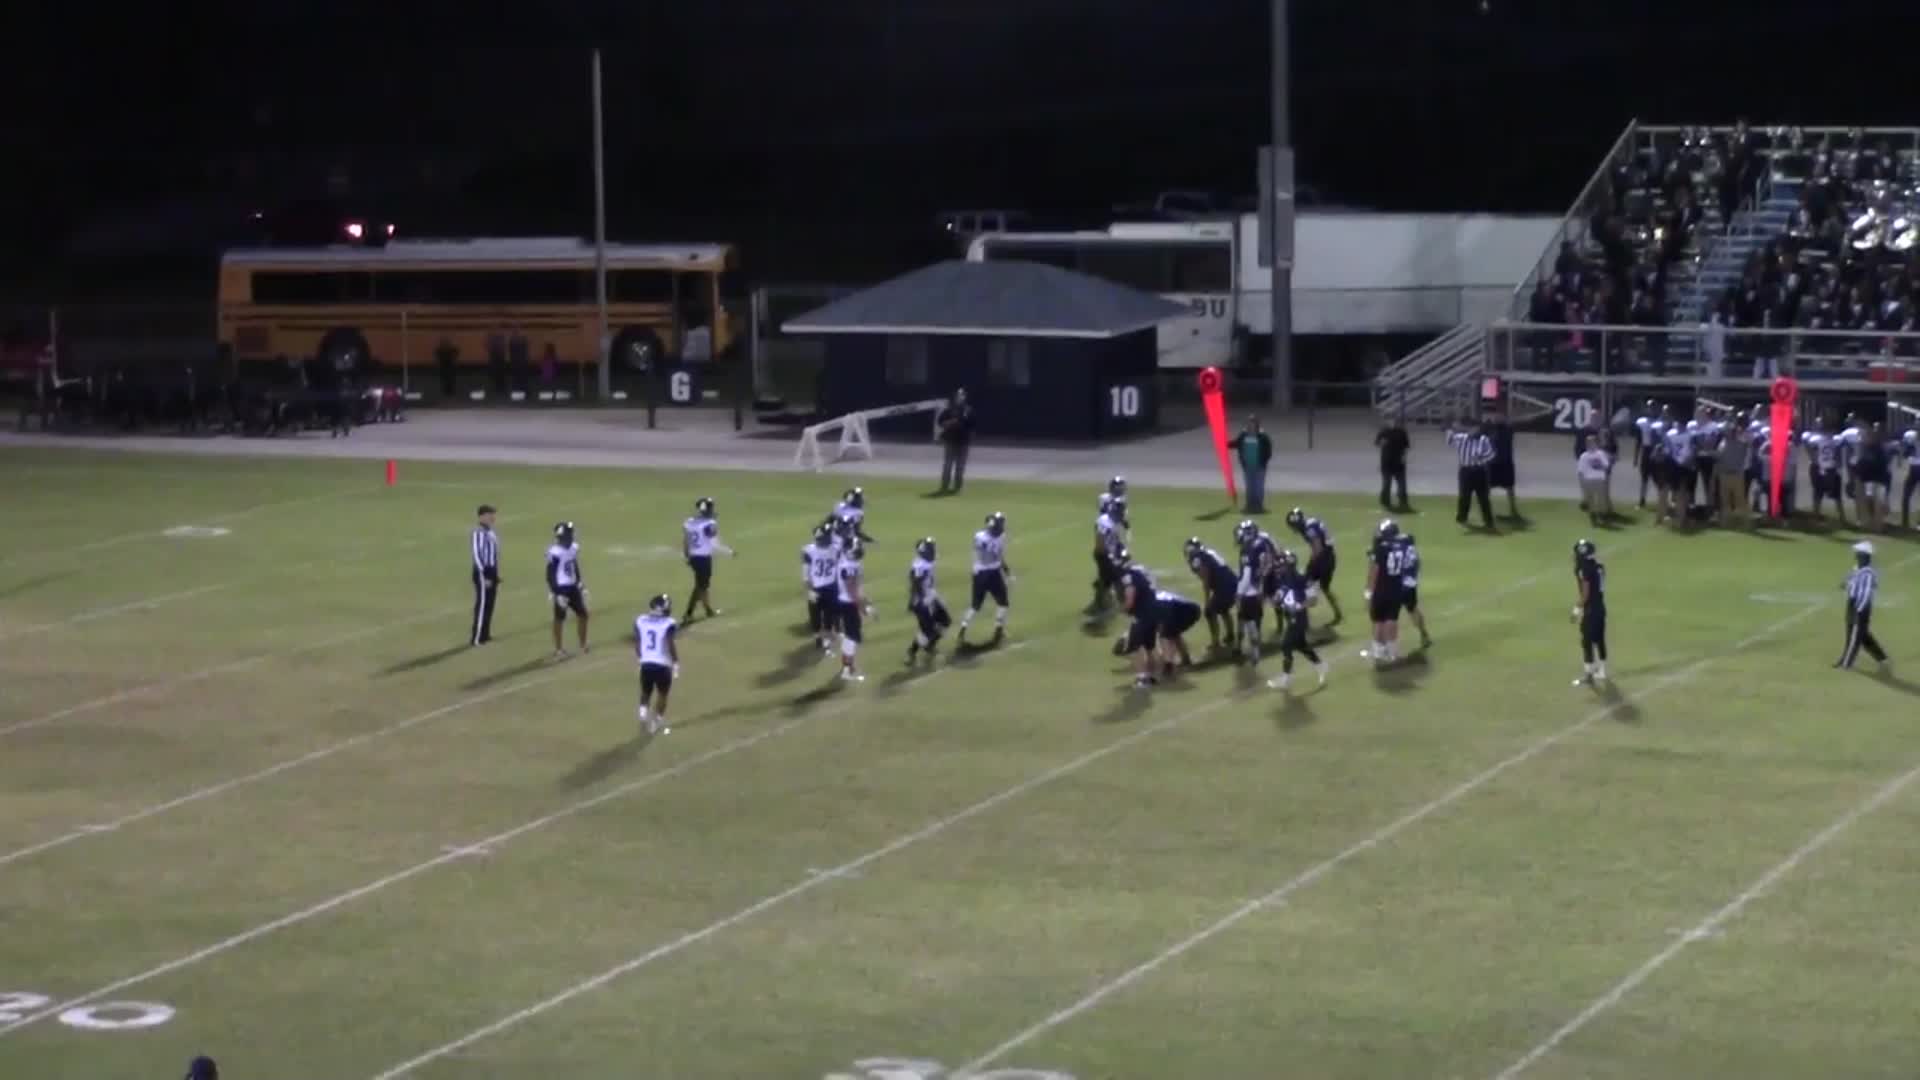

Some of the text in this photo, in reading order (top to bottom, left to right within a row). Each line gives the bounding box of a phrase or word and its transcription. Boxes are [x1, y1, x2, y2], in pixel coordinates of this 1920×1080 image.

[671, 371, 690, 401] G
[1110, 386, 1139, 416] 10
[1553, 398, 1592, 429] 20
[647, 629, 657, 650] 3
